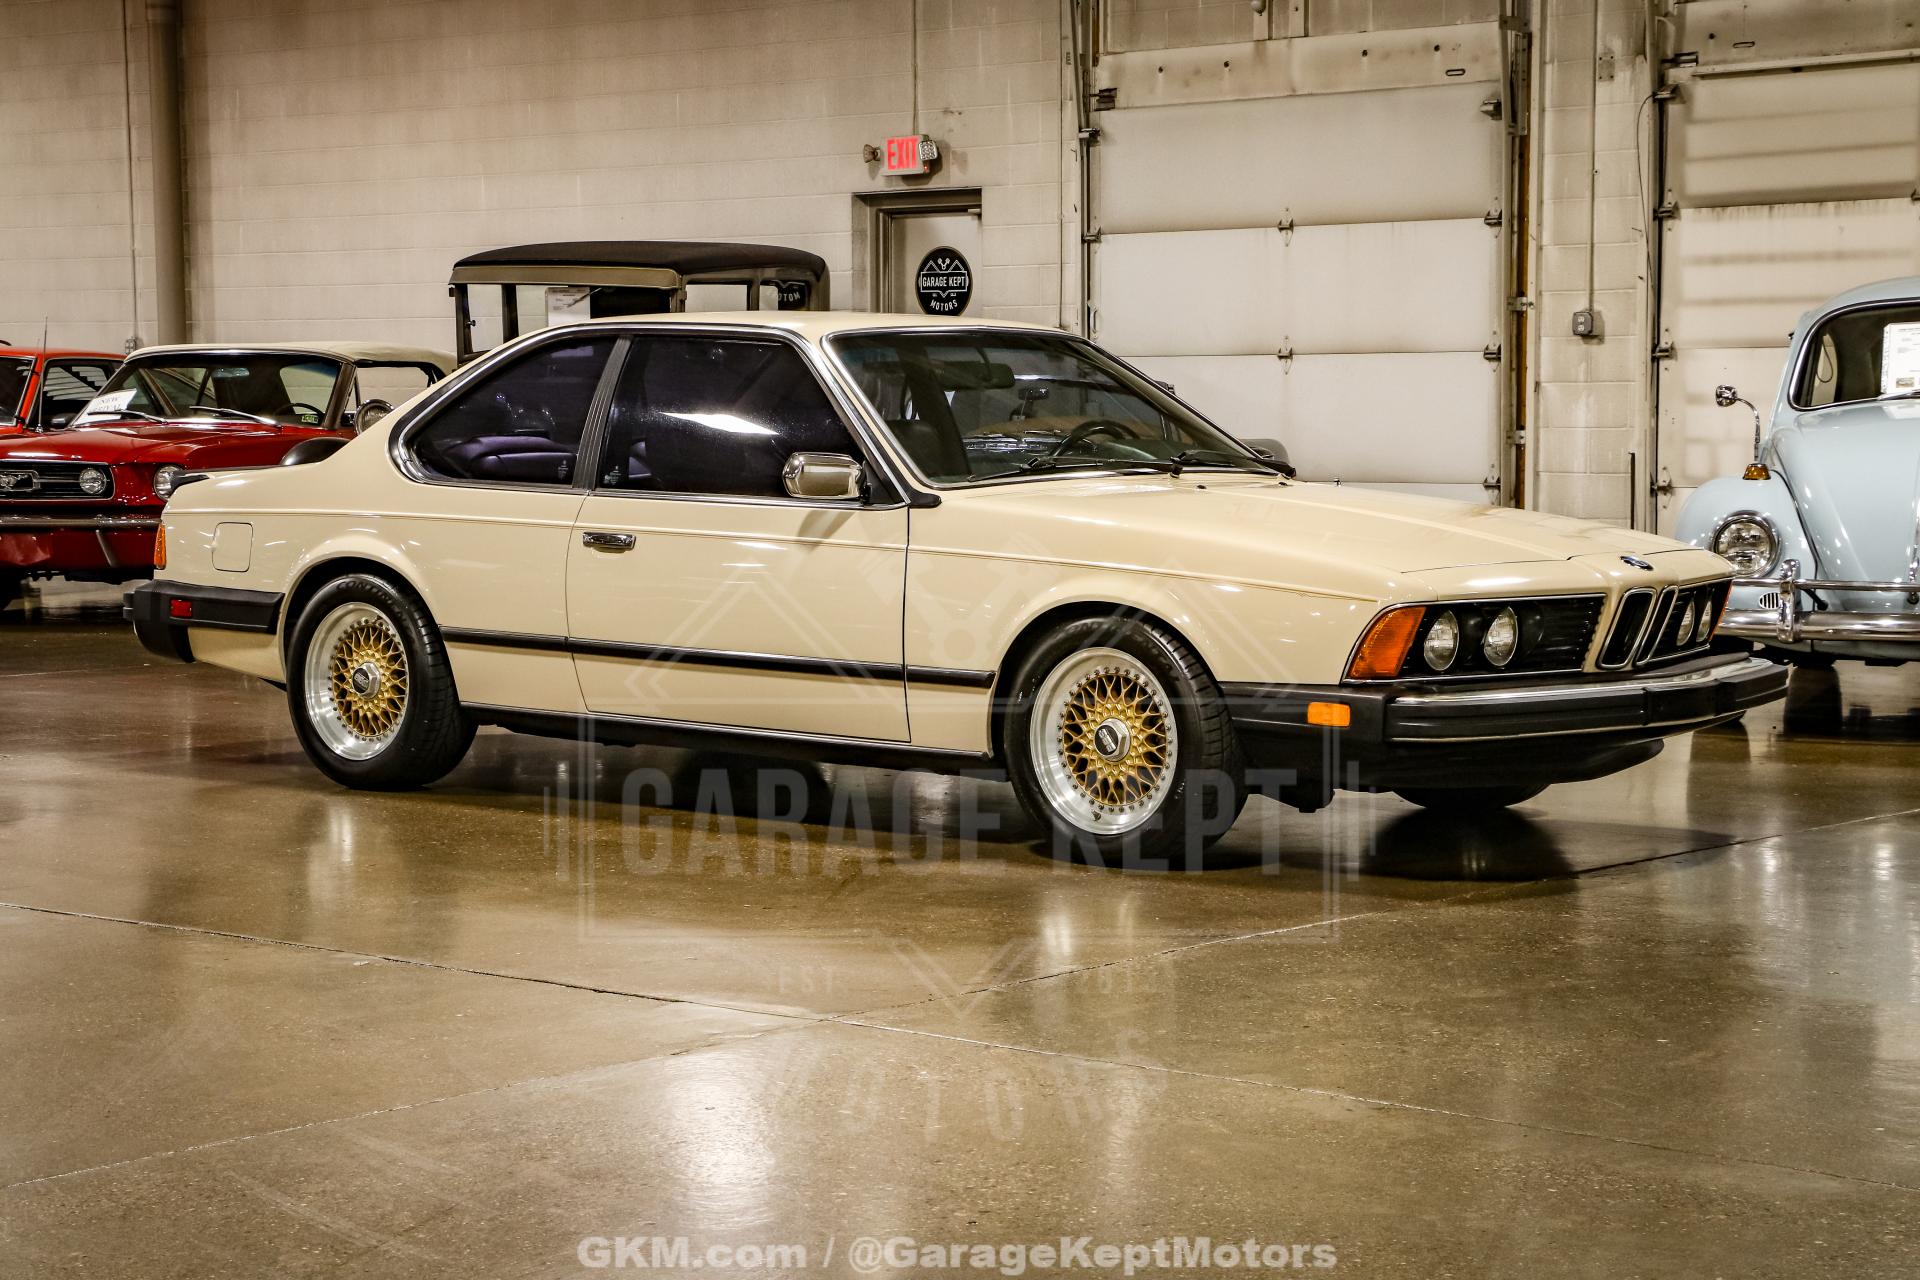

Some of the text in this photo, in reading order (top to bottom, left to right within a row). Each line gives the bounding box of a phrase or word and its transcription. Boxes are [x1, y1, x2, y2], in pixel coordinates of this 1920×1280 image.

[886, 136, 918, 170] EXIT
[922, 276, 965, 287] GARAGE KEPT
[930, 299, 958, 312] MOTORS
